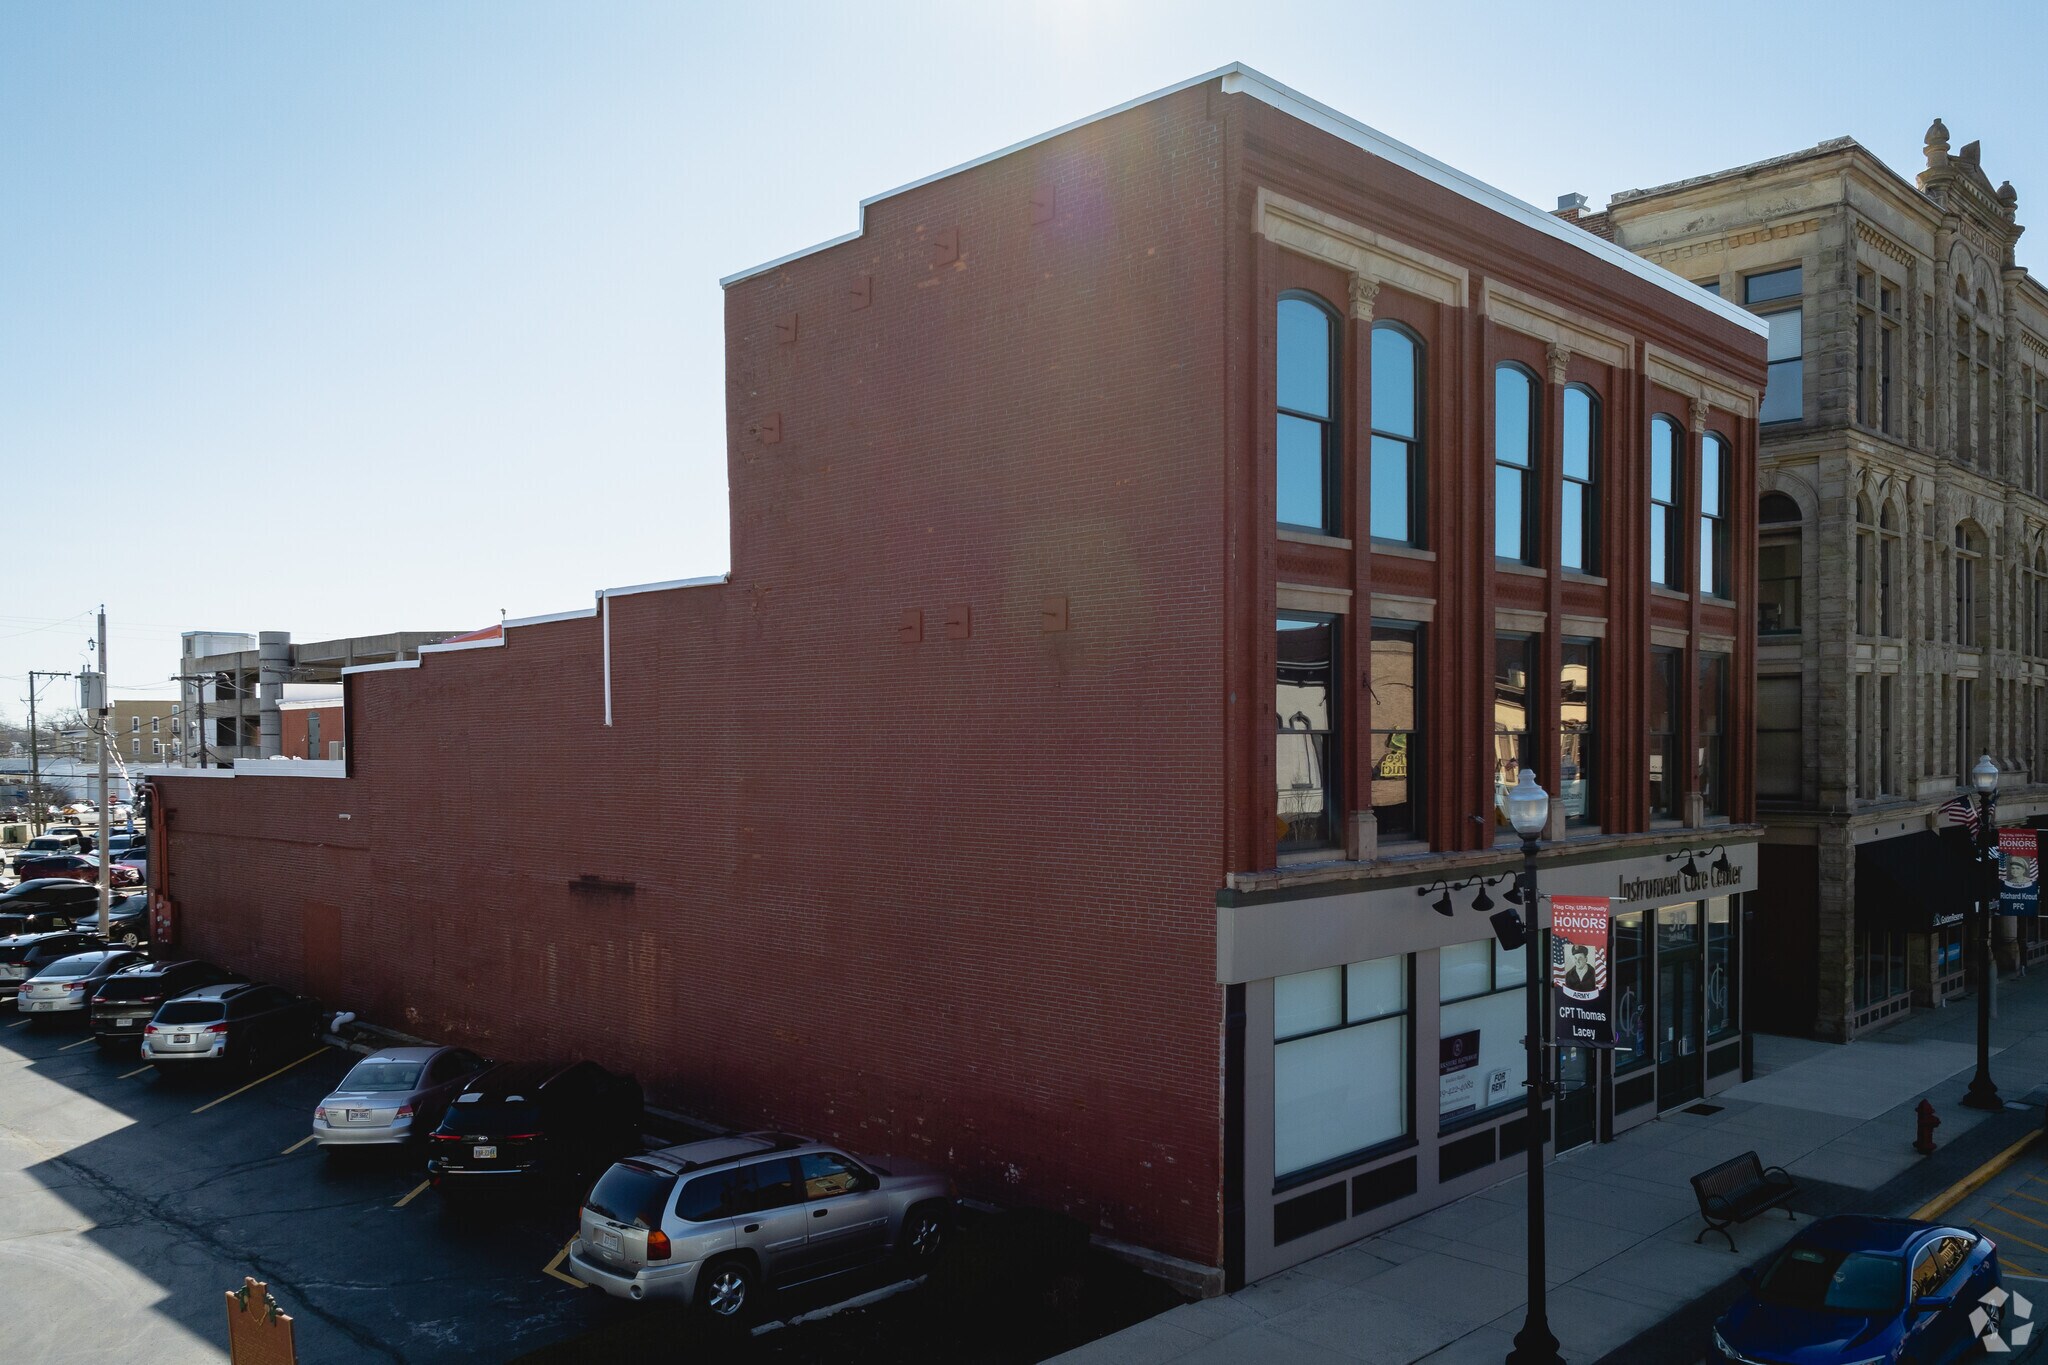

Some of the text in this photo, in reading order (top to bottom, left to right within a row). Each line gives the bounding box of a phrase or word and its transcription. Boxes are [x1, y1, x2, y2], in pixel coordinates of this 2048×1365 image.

[2000, 840, 2037, 848] HONORS
[1619, 870, 1682, 904] Instrument
[1711, 861, 1743, 888] Center
[2000, 892, 2021, 900] Richard
[1554, 916, 1607, 929] HONORS
[1669, 910, 1688, 932] 319
[1572, 991, 1590, 999] ARMY
[1559, 1006, 1606, 1021] CPT Thomas
[1572, 1025, 1596, 1040] Lacey
[1494, 1072, 1506, 1082] FOR
[1491, 1080, 1507, 1093] RENT
